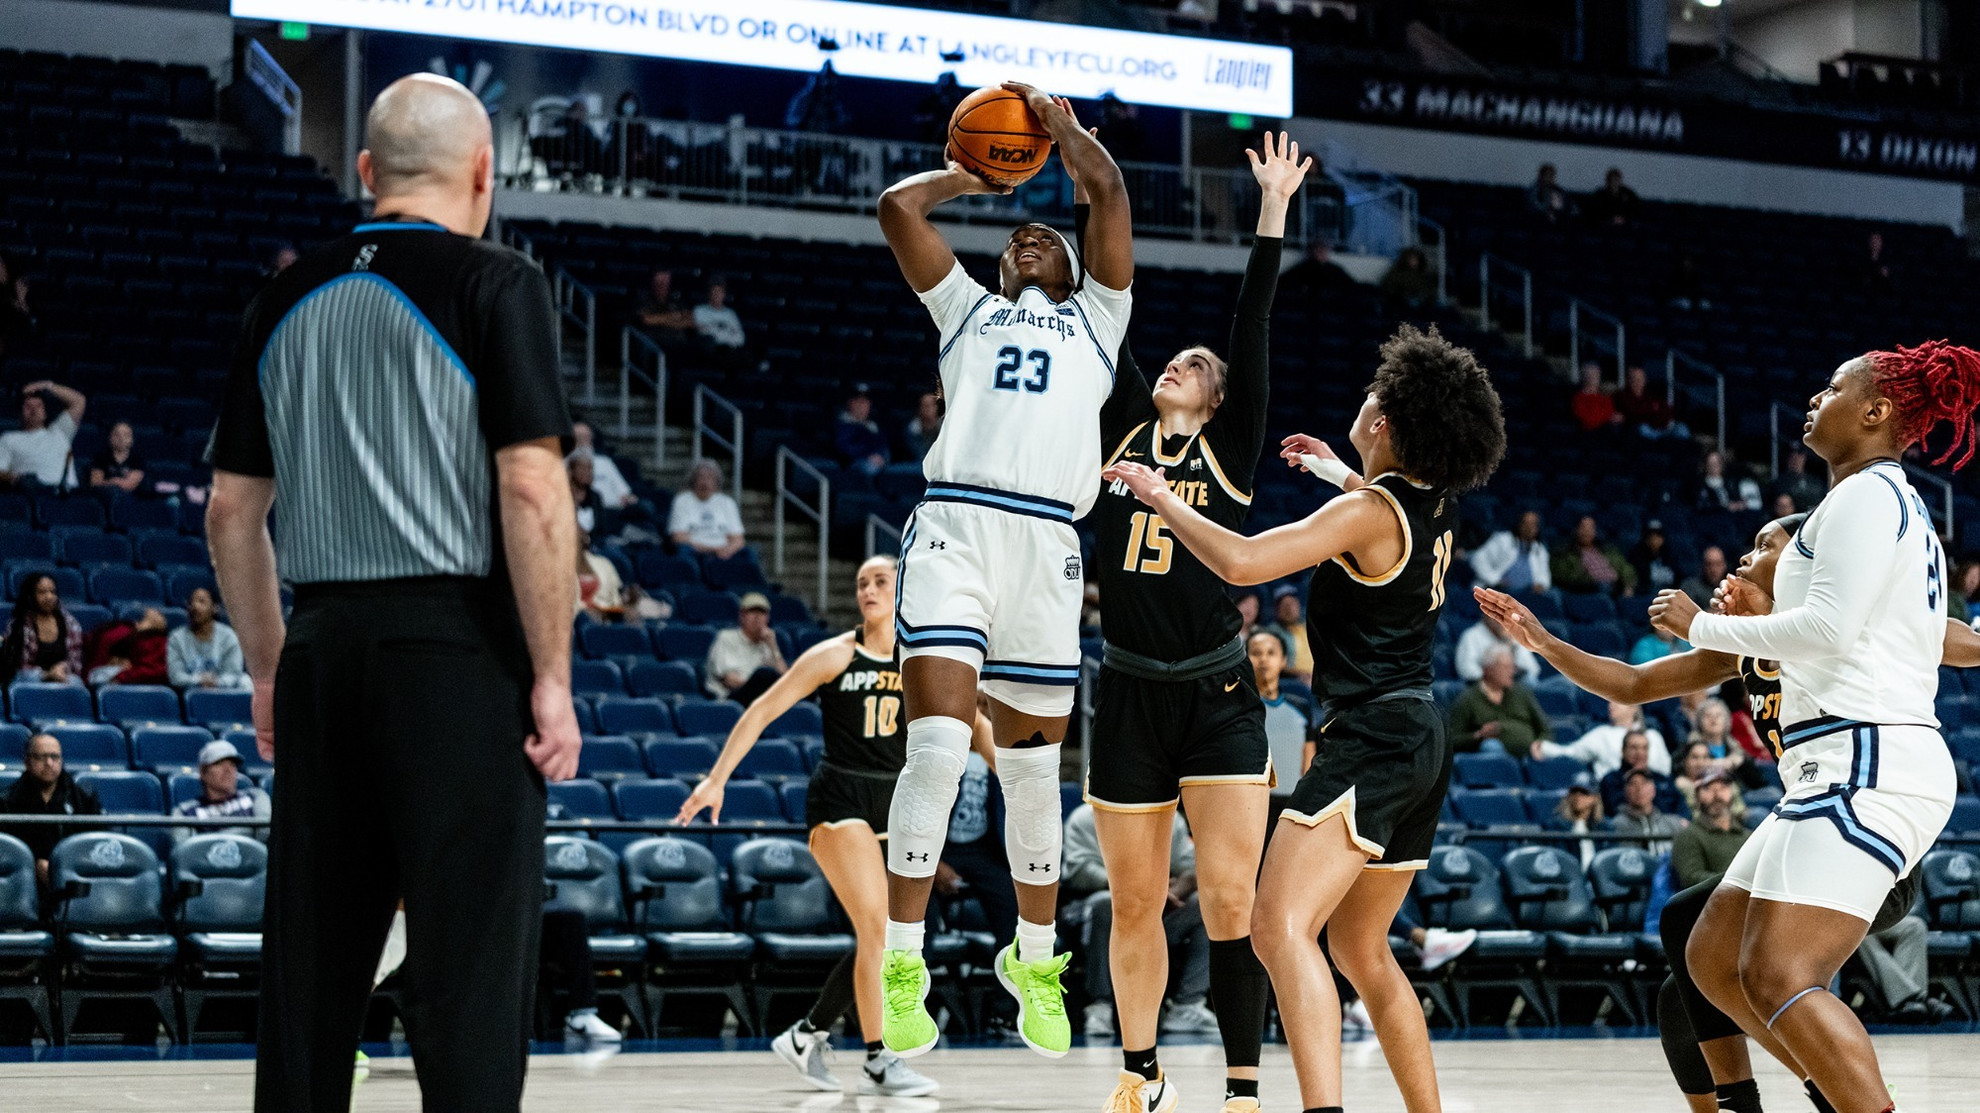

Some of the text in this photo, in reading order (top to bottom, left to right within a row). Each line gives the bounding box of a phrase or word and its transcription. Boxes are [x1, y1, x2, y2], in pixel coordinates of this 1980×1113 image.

[497, 0, 648, 26] HAMPTON
[657, 9, 729, 36] BLVD
[738, 18, 777, 40] OR
[898, 35, 928, 54] AT
[1204, 53, 1272, 91] Langley
[1361, 77, 1404, 115] 33
[988, 144, 1039, 163] NCAA
[1839, 130, 1977, 172] 13 DIXON
[980, 308, 1076, 342] Monarchs
[993, 344, 1052, 395] 23
[1123, 511, 1173, 575] 15
[1427, 529, 1453, 612] 11
[863, 695, 900, 738] 10
